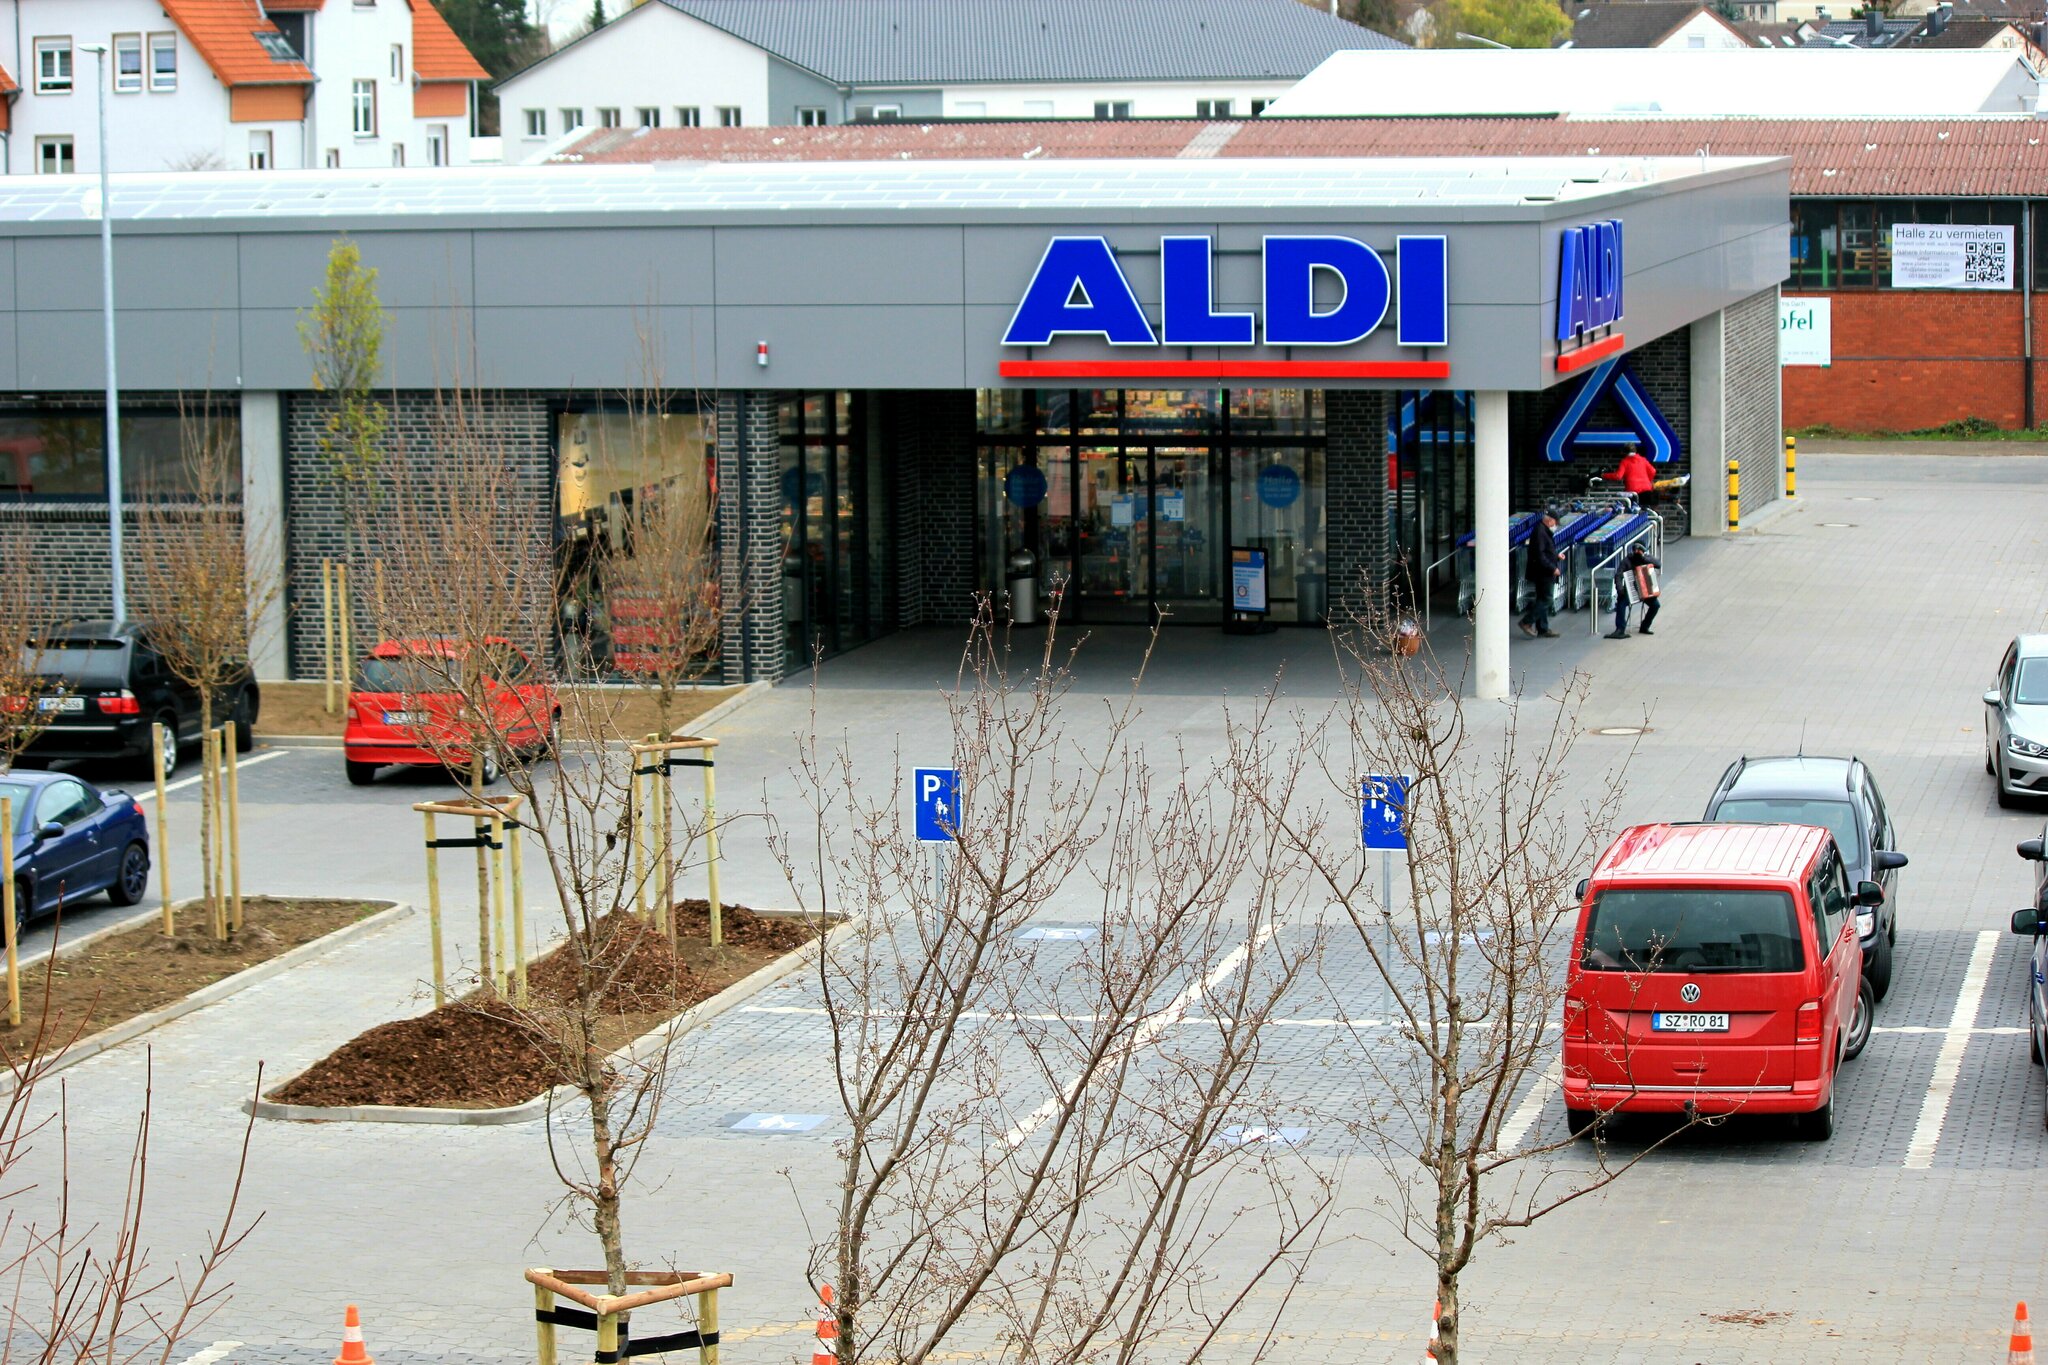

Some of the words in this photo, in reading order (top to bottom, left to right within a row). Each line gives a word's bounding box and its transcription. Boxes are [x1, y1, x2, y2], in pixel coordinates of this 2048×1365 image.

[1896, 228, 1925, 239] Halle
[1929, 230, 1943, 239] zu
[1946, 229, 2003, 240] vermieten
[1000, 235, 1448, 346] ALDI
[1558, 219, 1624, 340] ALDI
[923, 774, 941, 802] P
[1371, 781, 1389, 809] P
[1665, 1014, 1682, 1027] SZ
[1689, 1014, 1706, 1027] RO
[1709, 1014, 1724, 1027] 81
